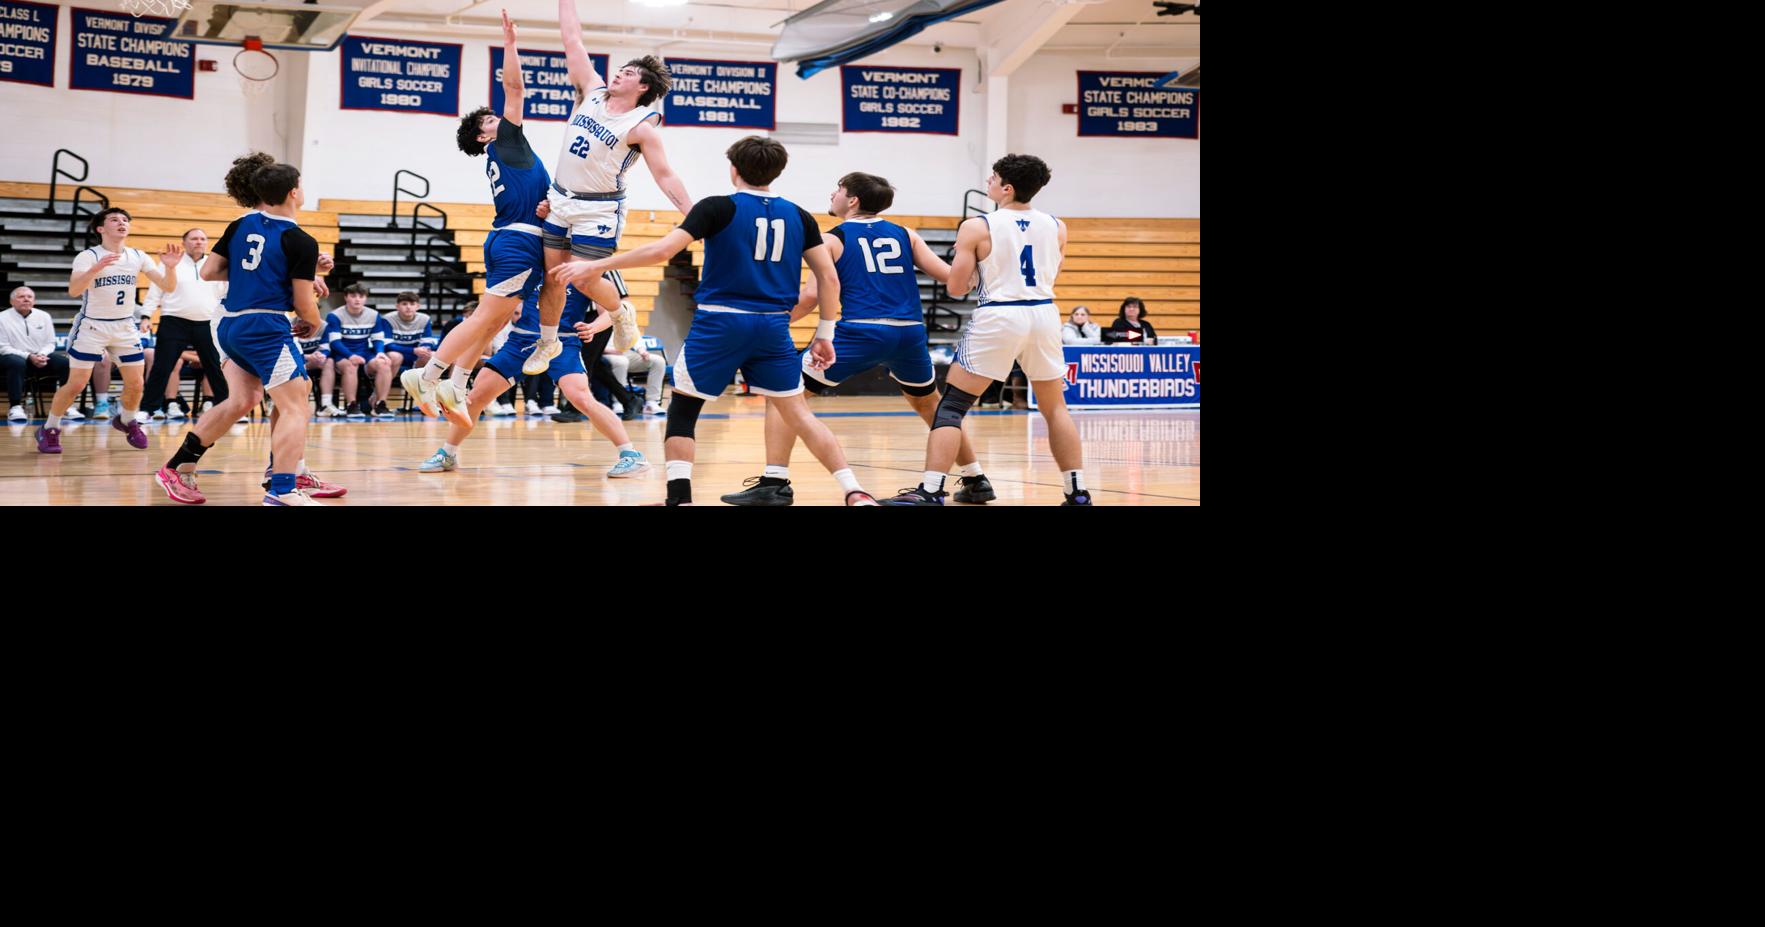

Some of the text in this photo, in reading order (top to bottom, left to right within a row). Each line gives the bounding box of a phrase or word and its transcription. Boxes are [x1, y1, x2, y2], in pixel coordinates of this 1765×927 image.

[0, 6, 30, 20] CLASS
[0, 23, 50, 43] AMPIONS
[85, 16, 167, 35] VERMONT DIVISI
[0, 43, 44, 60] OCCER
[77, 33, 190, 58] STATE CHAMPIONS
[361, 42, 442, 59] VERMONT
[86, 54, 180, 73] BASEBALL
[351, 57, 450, 78] INVITATIONAL CHAMPIONS
[670, 63, 713, 76] VERMONT
[716, 66, 755, 78] DIVISION
[112, 73, 154, 88] 1979
[358, 76, 443, 93] GIRLS SOCCER
[862, 71, 940, 84] VERMONT
[1099, 77, 1156, 88] VERMO
[671, 77, 771, 96] TATE CHAMPIONS
[851, 85, 951, 101] STATE CO-CHAMPIONS
[381, 93, 421, 106] 1980
[672, 95, 762, 110] BASEBALL
[1084, 90, 1194, 105] STATE CHAMPIONS
[529, 103, 567, 115] 1981
[860, 101, 943, 115] GIRLS SOCCER
[1087, 106, 1191, 119] GIRLS SOCCER
[698, 110, 736, 123] 1981
[881, 116, 921, 128] 1982
[1117, 120, 1158, 132] 1983
[569, 135, 590, 159] 22
[754, 217, 785, 263] 11
[241, 233, 266, 271] 3
[858, 237, 904, 274] 12
[1020, 244, 1036, 287] 4
[116, 290, 126, 306] 2
[1080, 353, 1191, 374] MISSISQUOI VALLEY
[1077, 378, 1195, 399] THUNDERBIRDS
